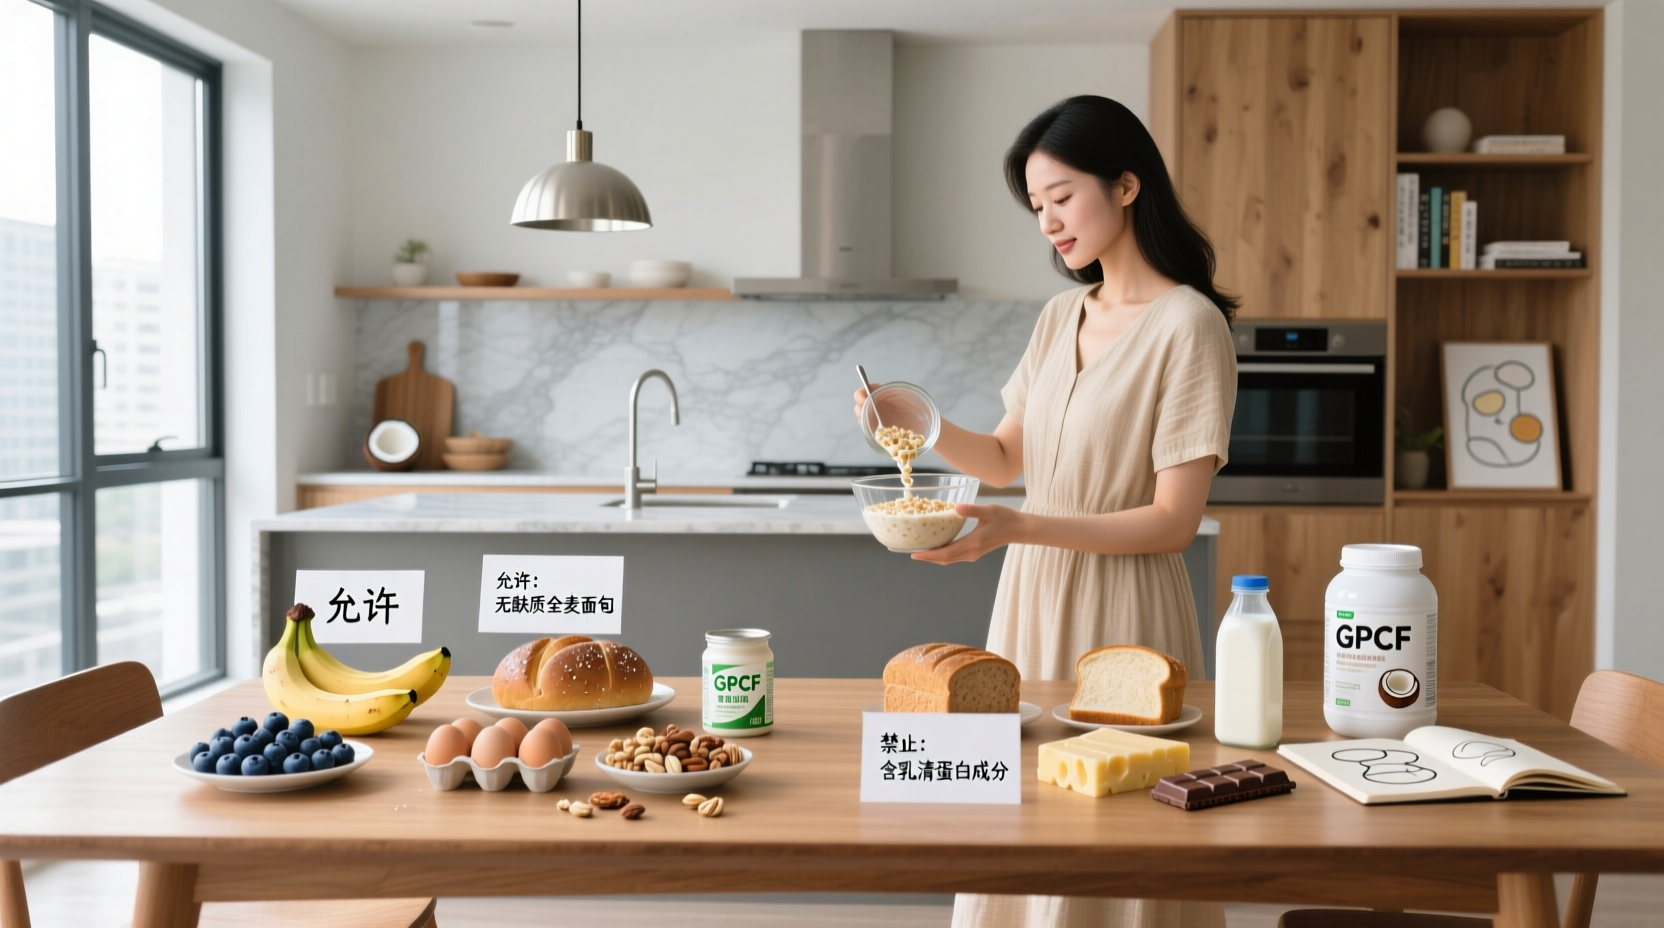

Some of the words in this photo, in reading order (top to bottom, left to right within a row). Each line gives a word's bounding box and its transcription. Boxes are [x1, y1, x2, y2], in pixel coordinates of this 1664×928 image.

[496, 571, 538, 591] 允许：
[326, 586, 400, 626] 允许
[1336, 624, 1412, 651] GPCF
[714, 674, 761, 692] GPCF
[880, 732, 926, 754] 禁止：
